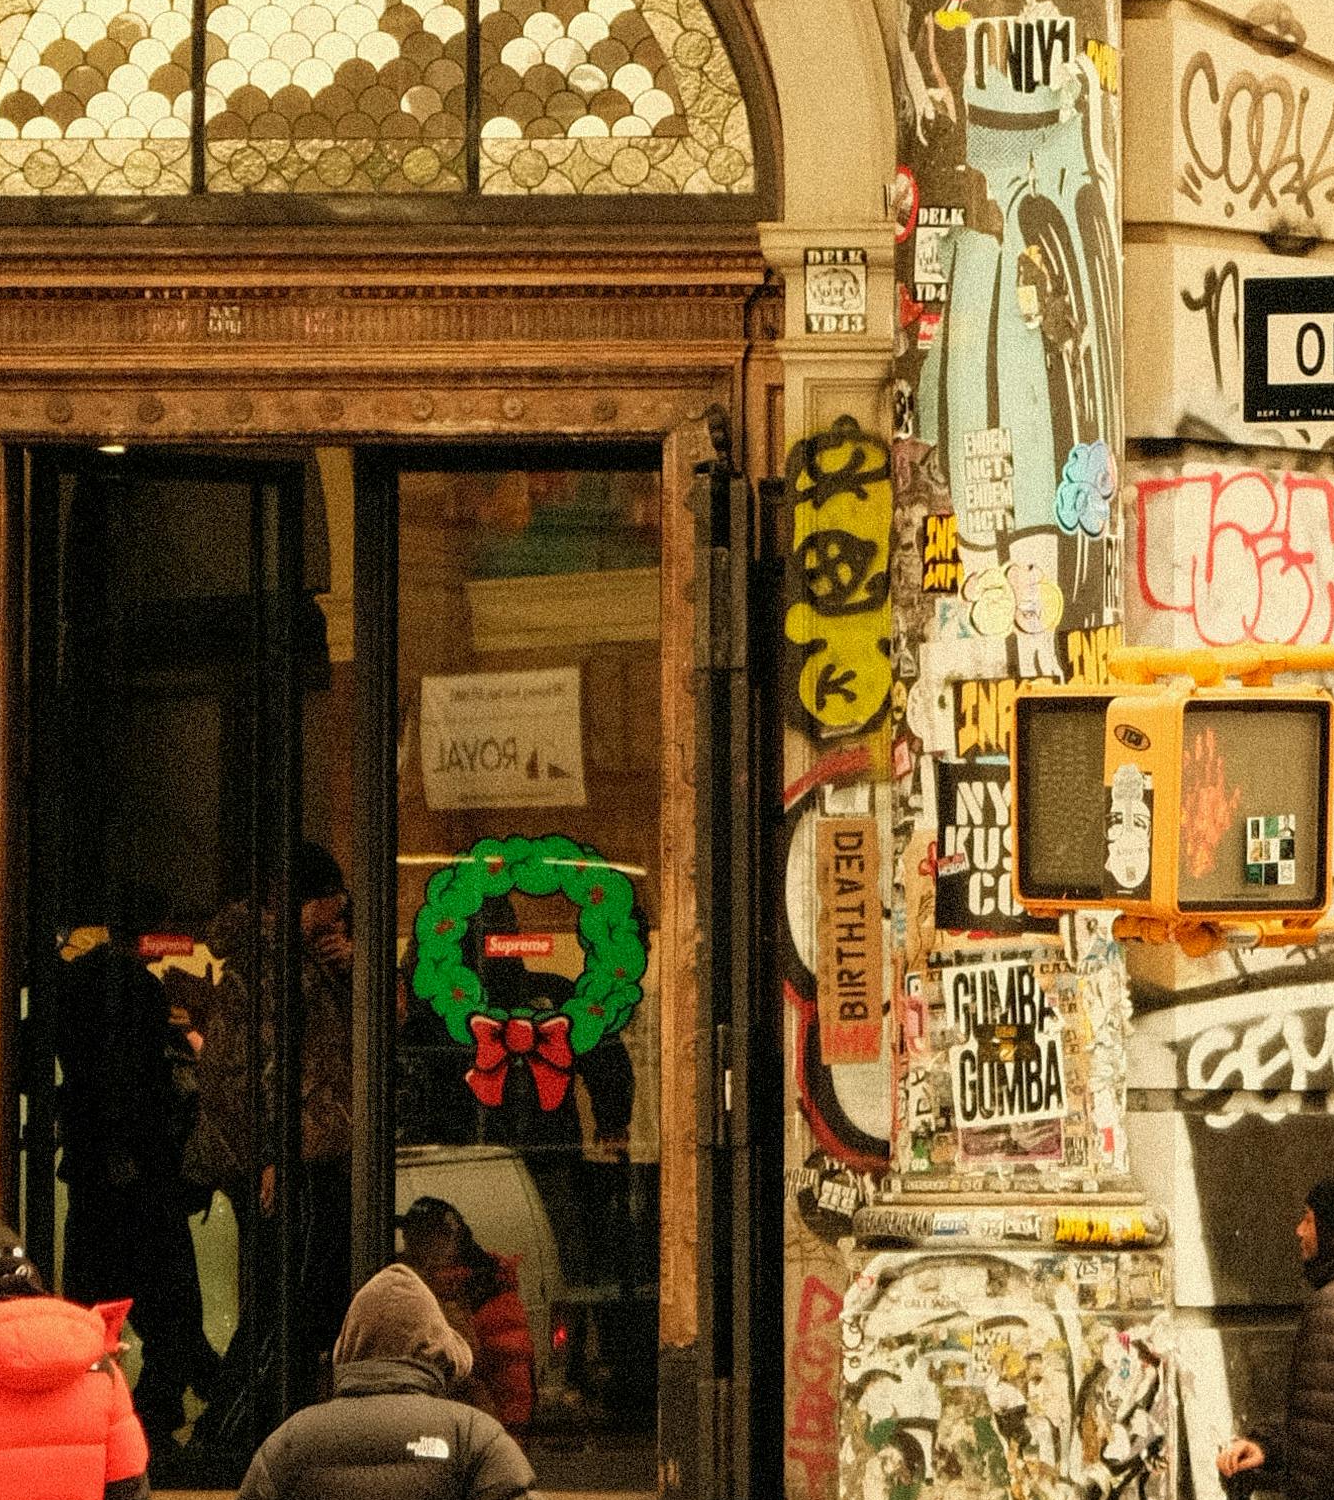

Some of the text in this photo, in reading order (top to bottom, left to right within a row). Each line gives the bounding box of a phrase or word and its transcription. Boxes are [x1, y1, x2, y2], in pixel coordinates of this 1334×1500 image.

[918, 207, 965, 226] DELK
[808, 250, 864, 264] DELK
[486, 936, 554, 956] Supreme
